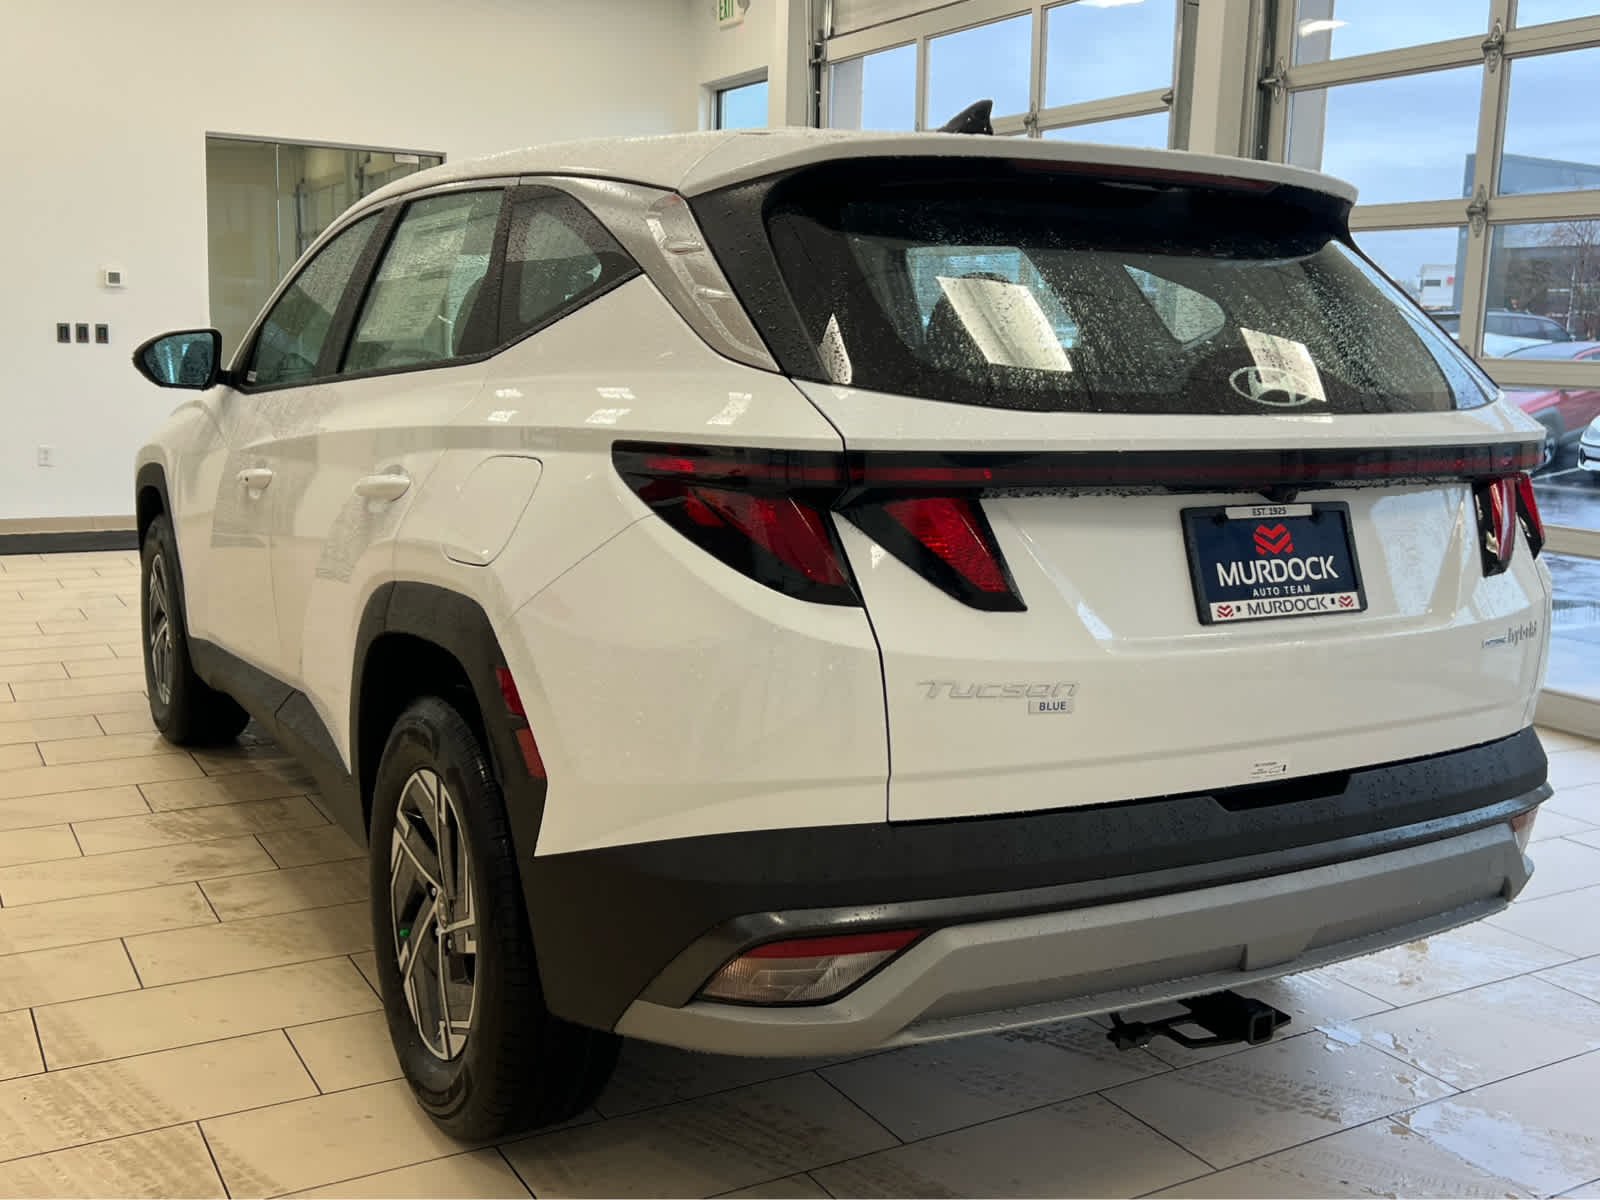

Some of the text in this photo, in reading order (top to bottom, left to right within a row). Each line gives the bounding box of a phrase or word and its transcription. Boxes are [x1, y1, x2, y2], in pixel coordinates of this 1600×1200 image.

[1216, 555, 1339, 587] MURDOCK
[1252, 584, 1312, 598] AUTO TEAM
[1247, 596, 1328, 616] MURDOCK
[1039, 701, 1067, 712] BLUE
